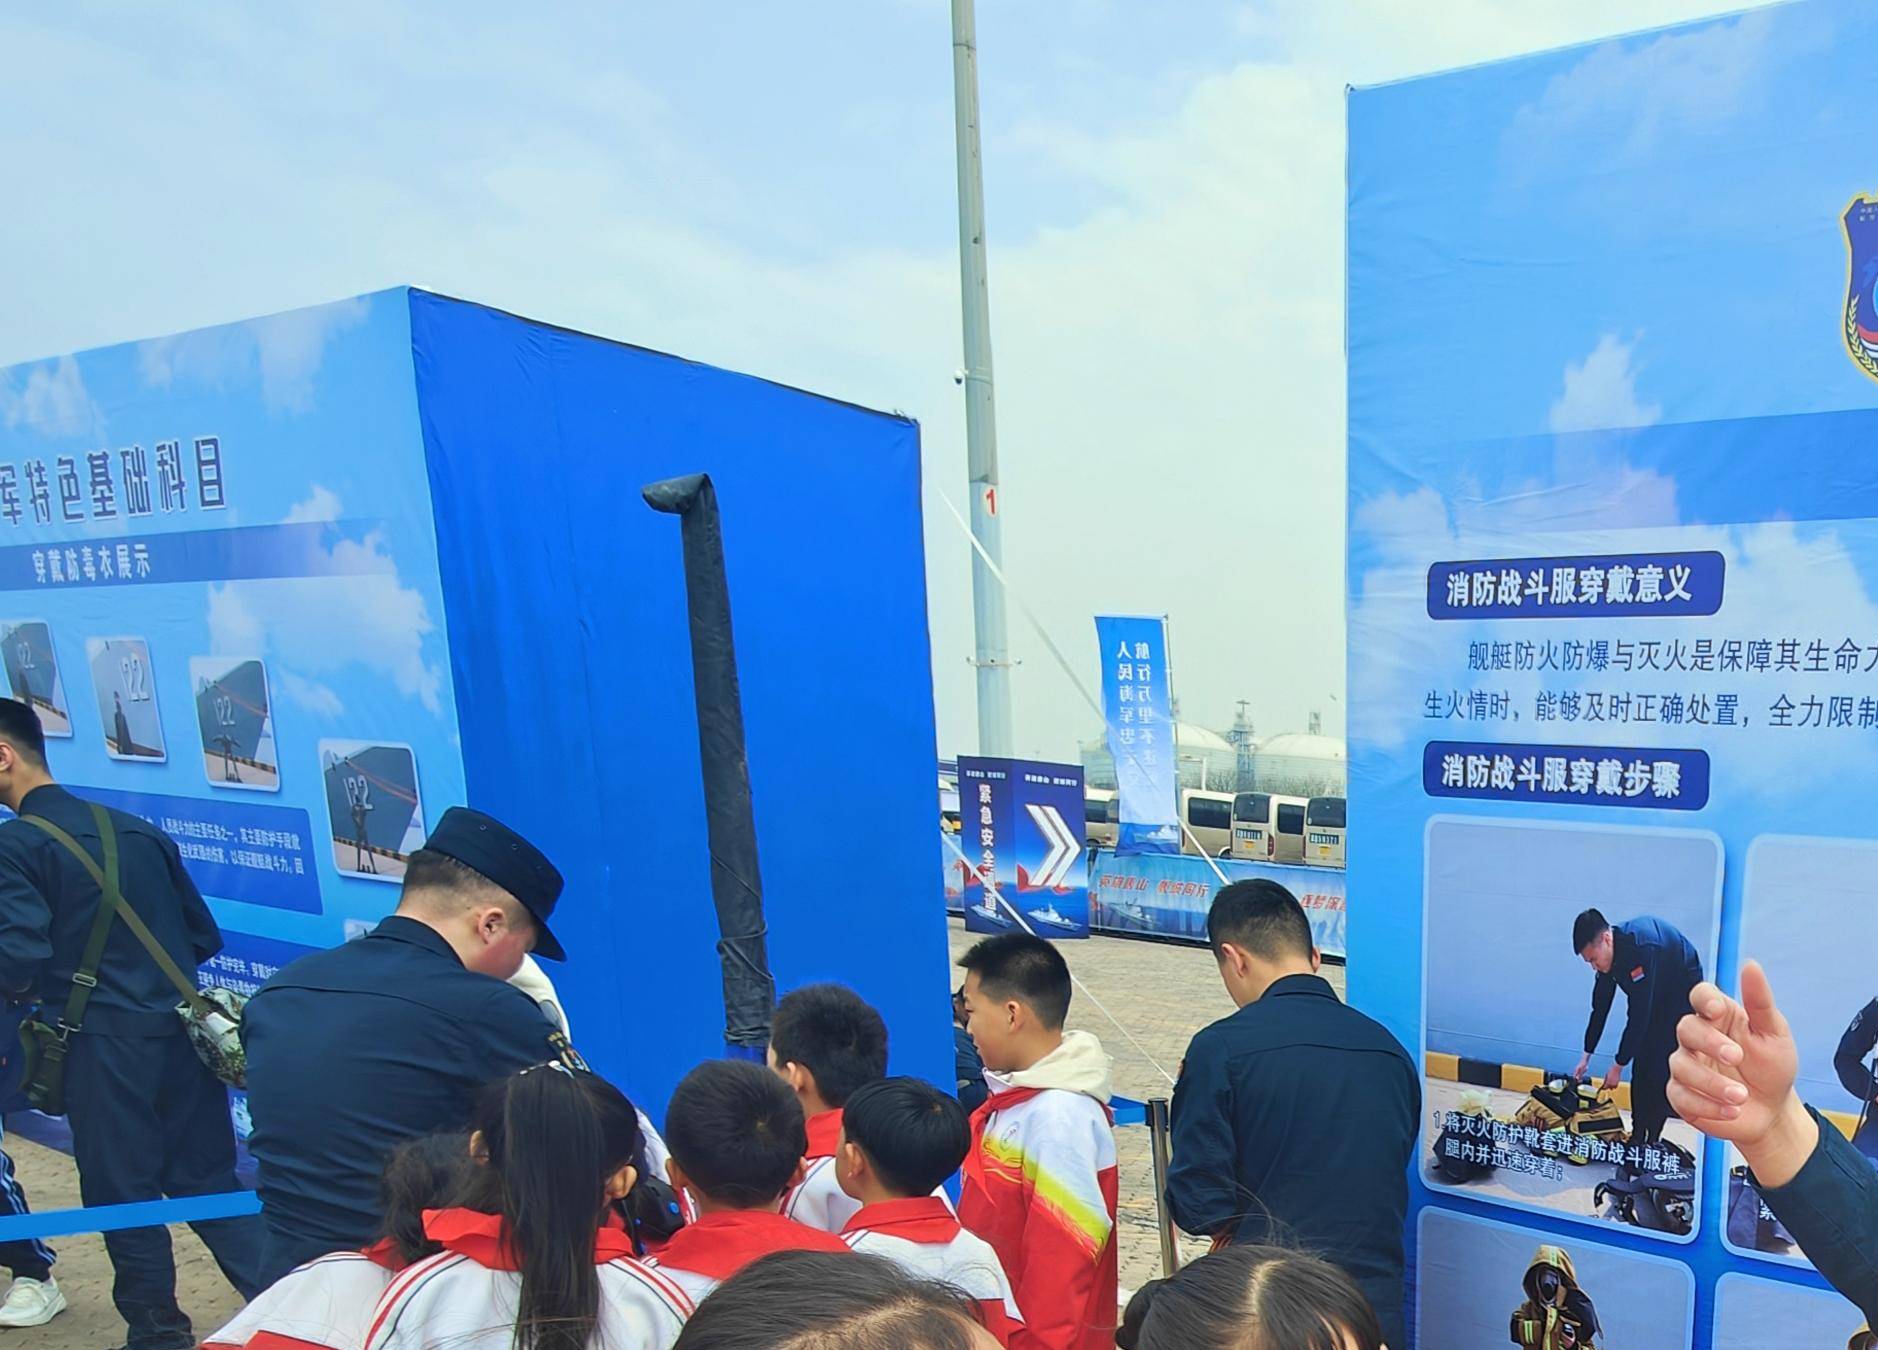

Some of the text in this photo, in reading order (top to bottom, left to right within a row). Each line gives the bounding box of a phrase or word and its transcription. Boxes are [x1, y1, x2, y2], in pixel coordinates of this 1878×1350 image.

[0, 436, 226, 526] 军特色基础科目
[32, 544, 150, 583] 穿戴防毒衣展示
[1446, 563, 1693, 607] 消防战斗服穿戴意义
[1441, 750, 1682, 799] 消防战斗服穿戴步骤
[1433, 1111, 1681, 1175] 1.将灭火防护靴套进消防战斗服裤
